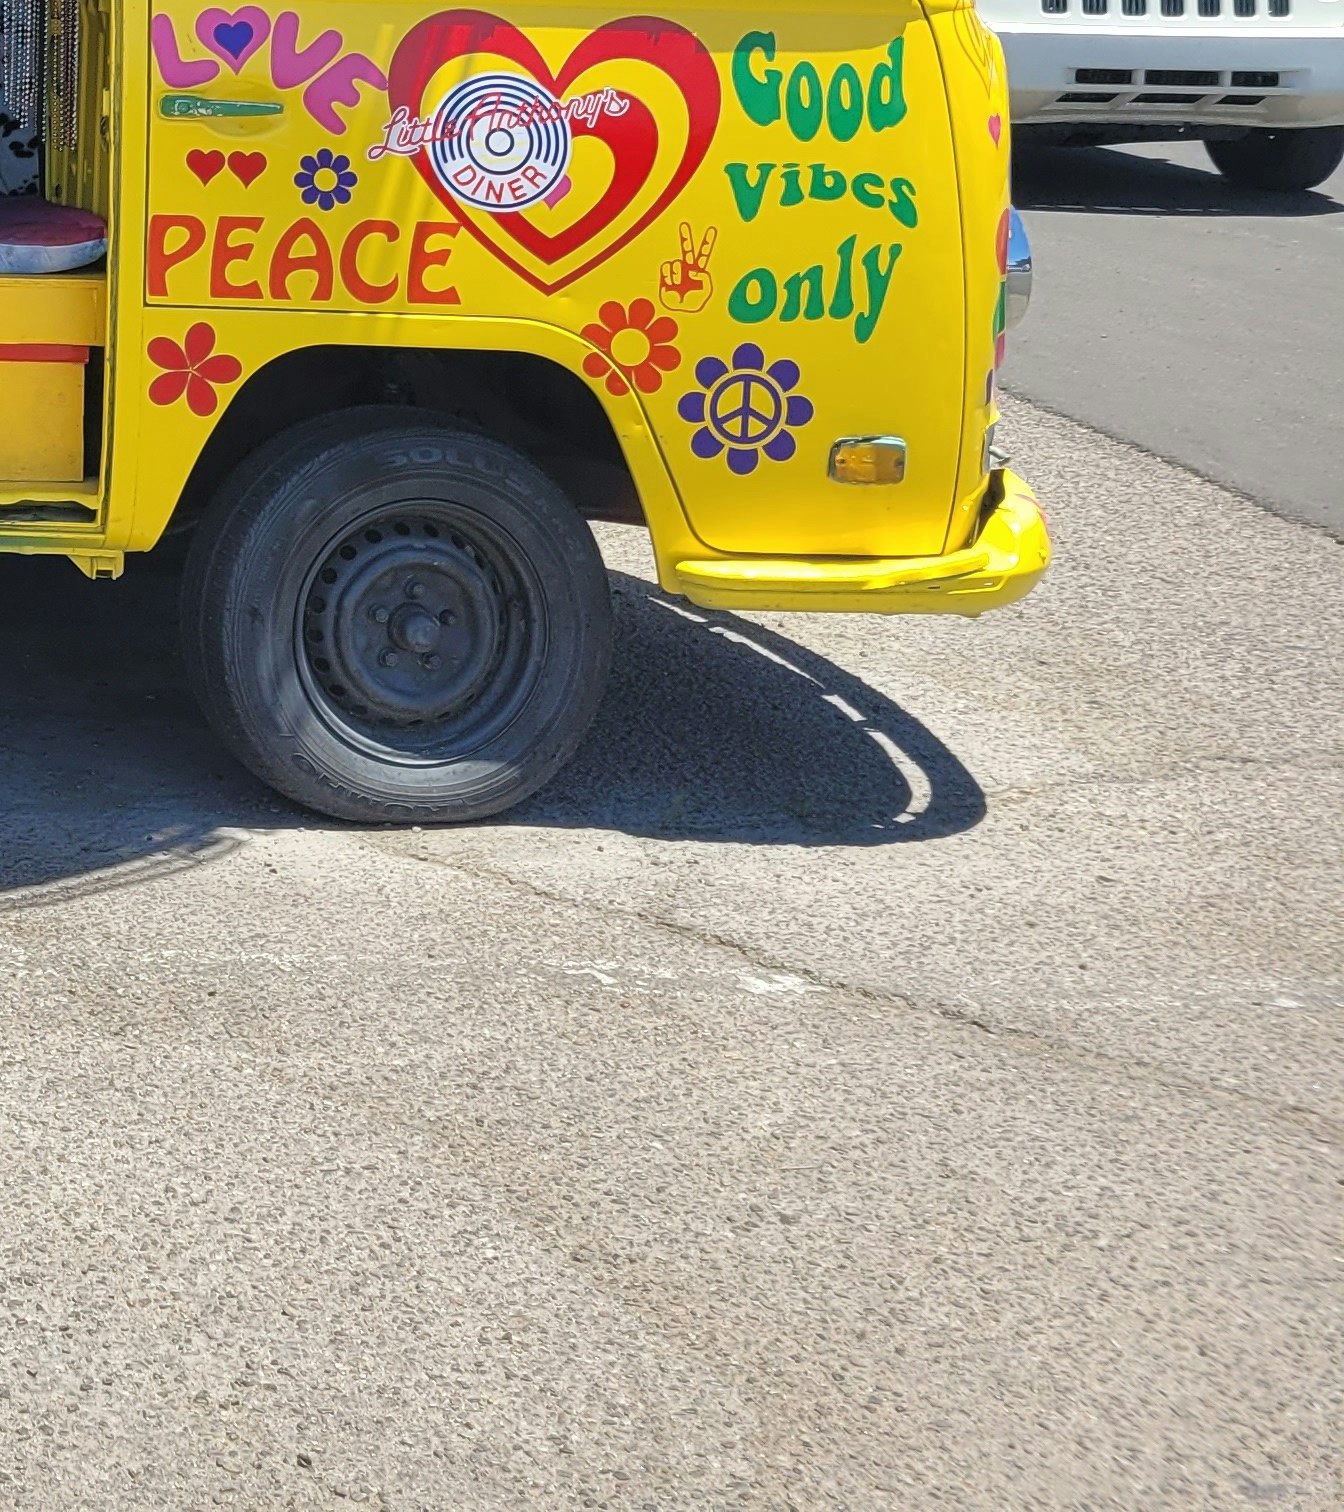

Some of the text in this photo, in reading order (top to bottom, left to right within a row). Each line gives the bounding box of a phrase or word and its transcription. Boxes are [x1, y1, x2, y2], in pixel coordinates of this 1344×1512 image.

[731, 29, 908, 143] Good
[367, 106, 461, 160] Little
[451, 164, 548, 204] DINER
[146, 214, 463, 306] PEACE
[727, 233, 903, 345] only
